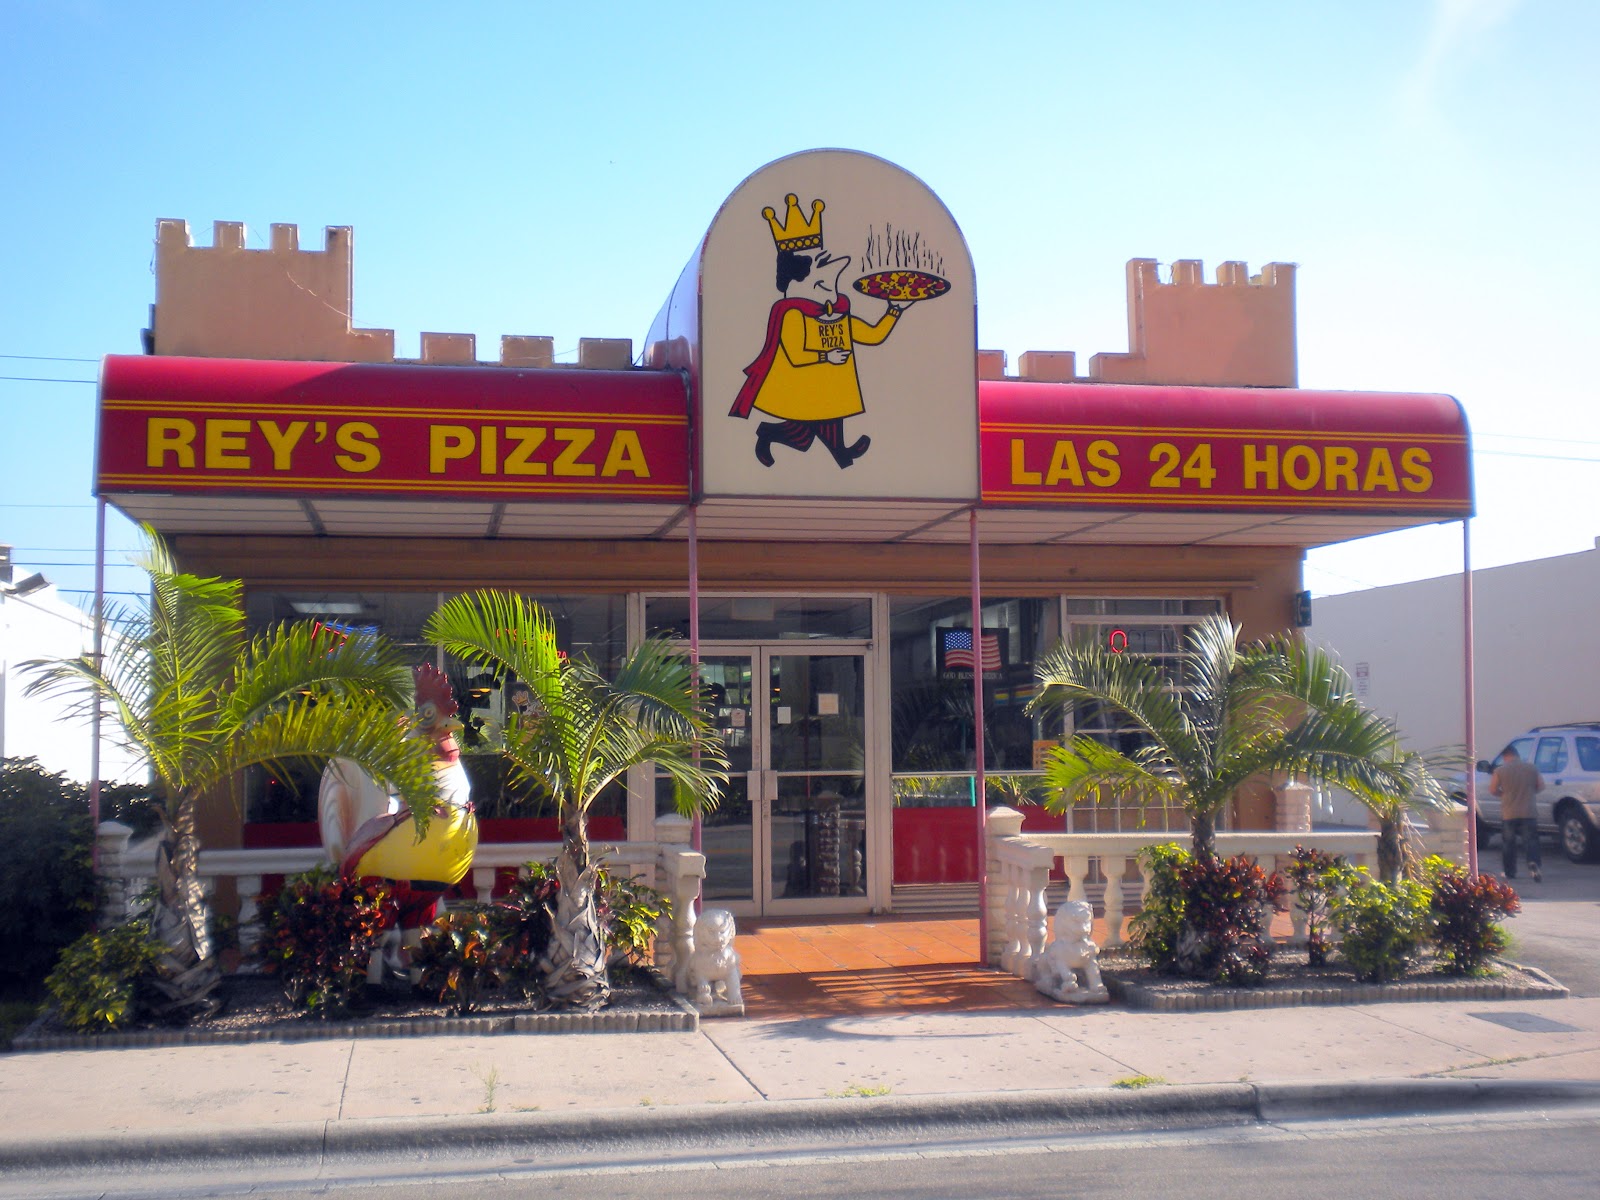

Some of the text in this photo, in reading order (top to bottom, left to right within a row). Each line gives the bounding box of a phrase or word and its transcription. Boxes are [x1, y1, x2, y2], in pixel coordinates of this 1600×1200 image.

[818, 324, 844, 337] REY'S
[821, 336, 846, 348] PIZZA
[146, 416, 652, 478] REY'S PIZZA
[1010, 438, 1434, 493] LAS 24 HORAS
